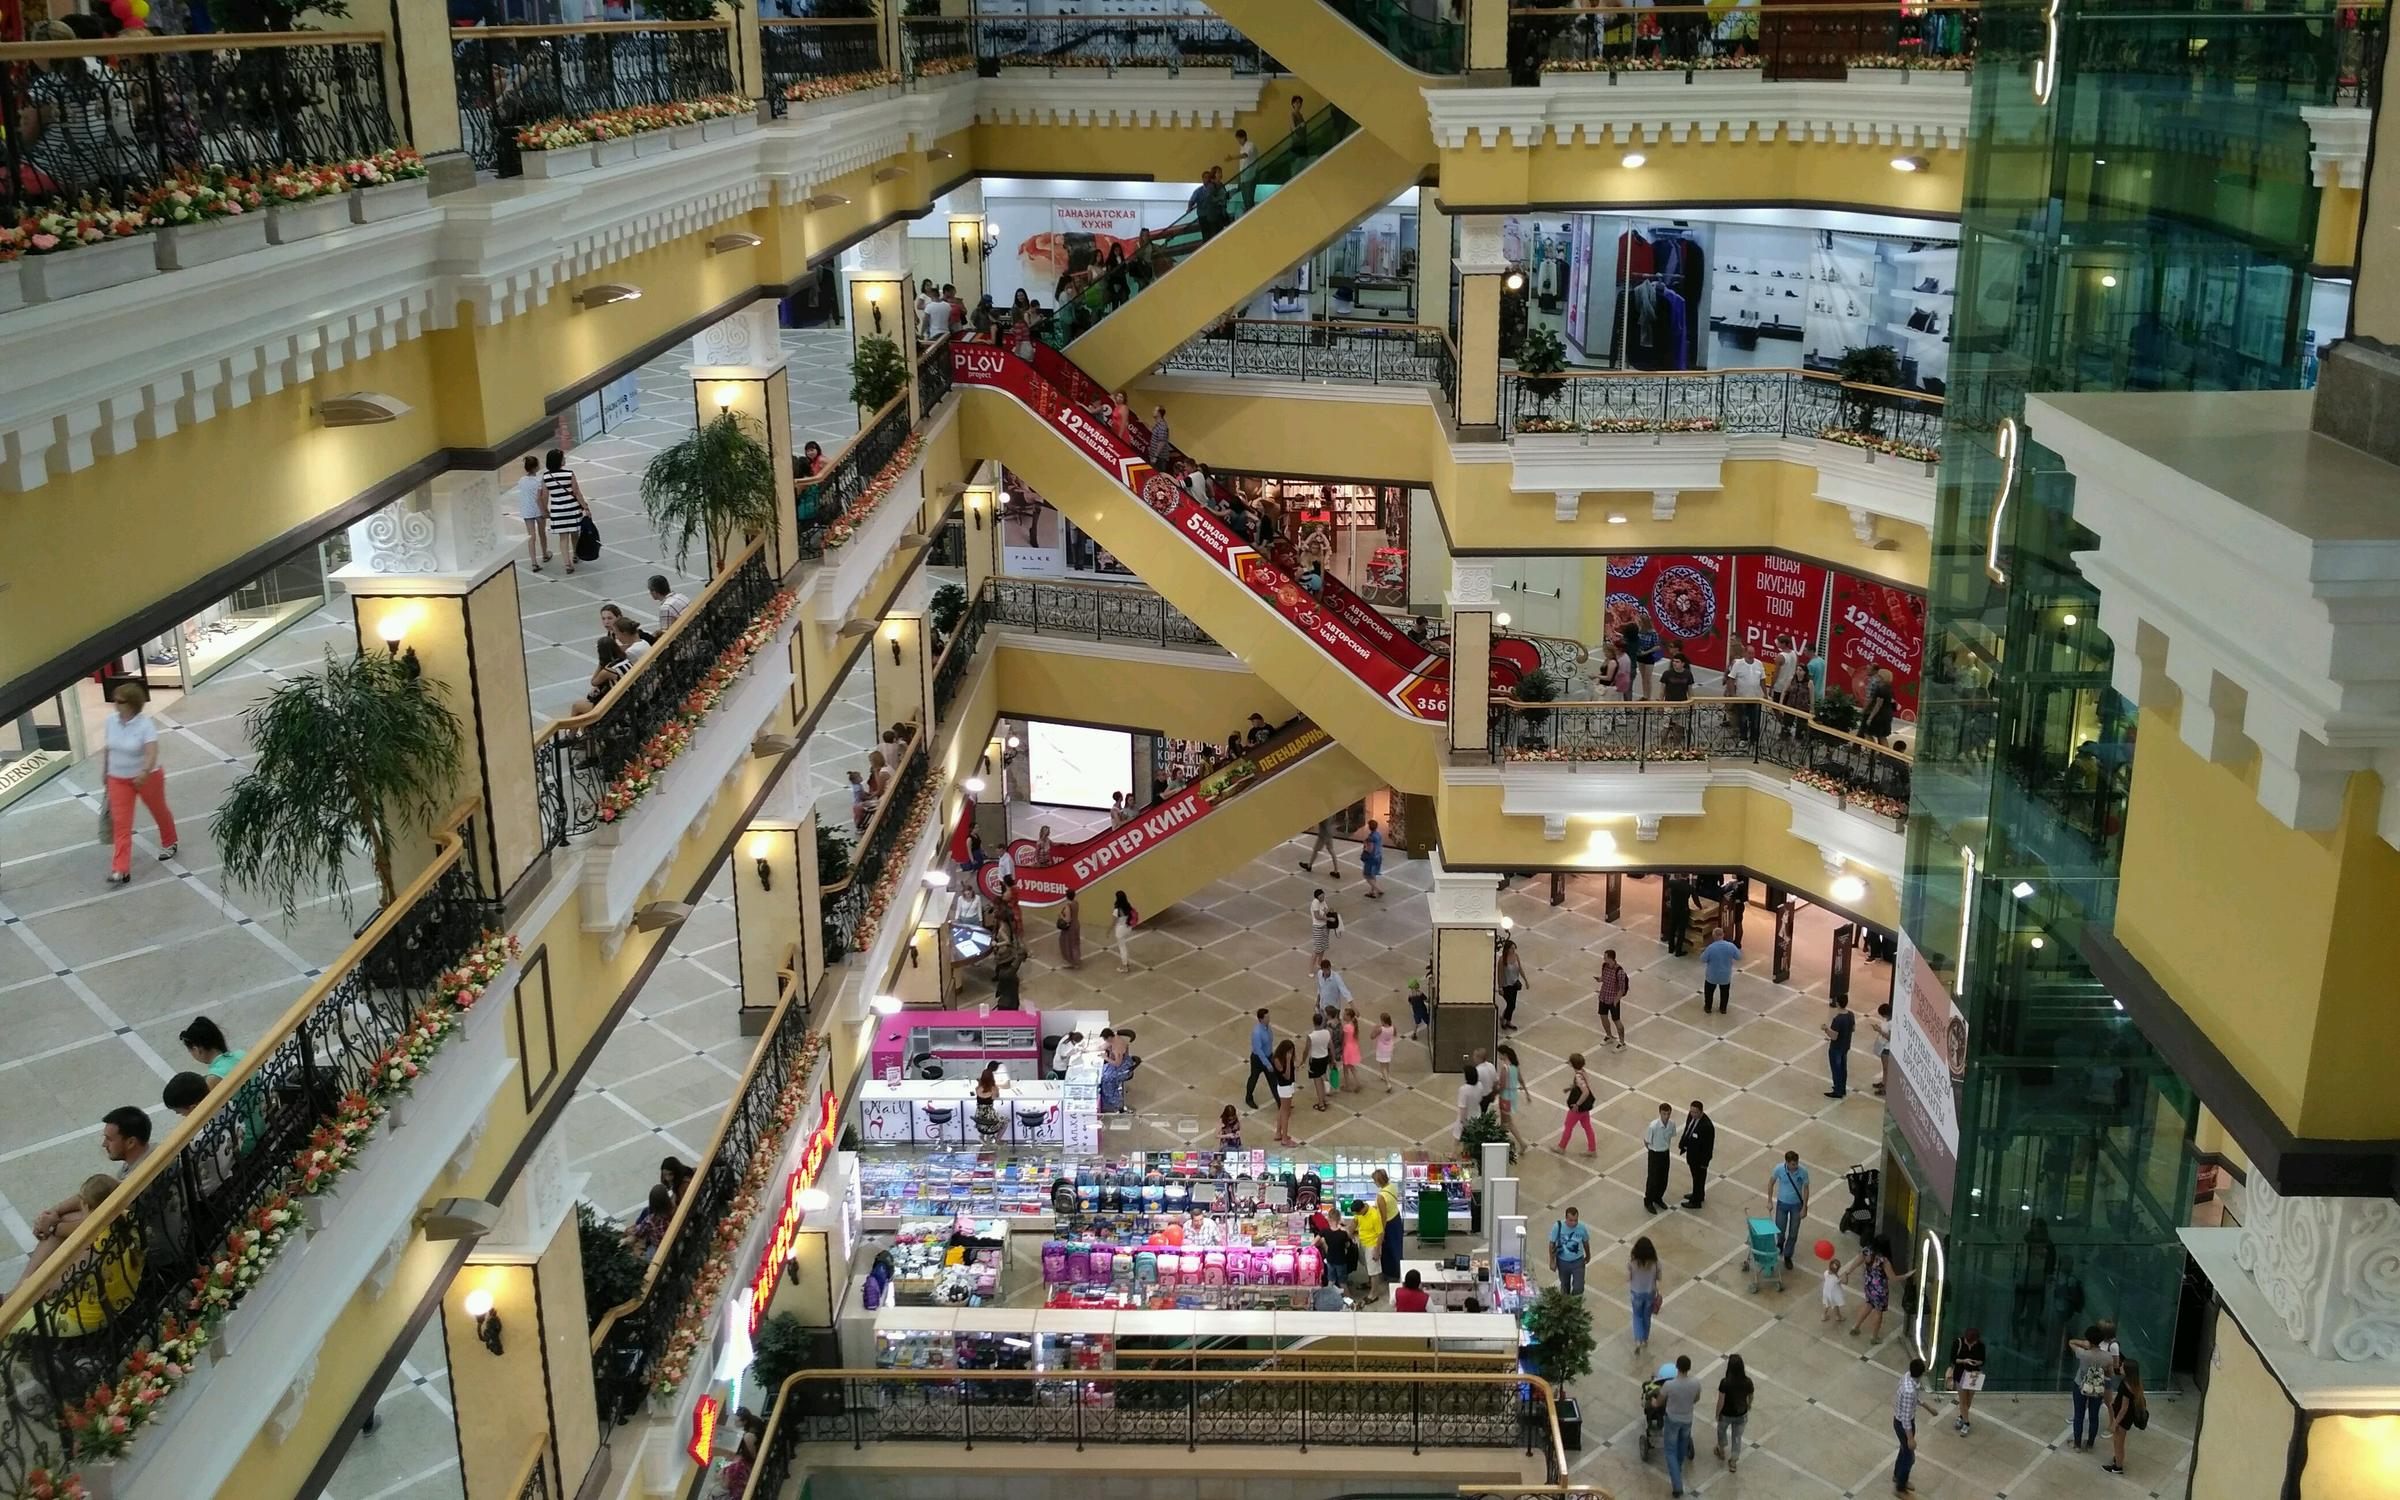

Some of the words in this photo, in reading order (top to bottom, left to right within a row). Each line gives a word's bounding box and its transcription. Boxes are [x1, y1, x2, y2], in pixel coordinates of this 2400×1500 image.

[1058, 208, 1136, 219] ПАНАЗИАТСКАЯ
[1081, 220, 1113, 229] КУХНЯ
[954, 354, 1005, 373] PLOV
[968, 371, 992, 380] project
[1057, 407, 1084, 434] 12
[1082, 422, 1109, 447] ВИДОВ
[1077, 429, 1119, 466] ШАШЛЫКА
[1186, 512, 1205, 530] 5
[1202, 520, 1230, 545] ВИДОВ
[1196, 528, 1224, 553] ПЛОВА
[1764, 555, 1801, 575] НОВАЯ
[1756, 571, 1806, 599] ВКУСНАЯ
[1343, 611, 1361, 627] ЧАЙ
[1766, 595, 1794, 618] ТВОЯ
[1844, 604, 1869, 631] 12
[1348, 604, 1394, 642] АВТОРСКИЙ
[1869, 617, 1897, 641] ВИДОВ
[1320, 628, 1337, 645] ЧАЙ
[1324, 621, 1371, 660] АВТОРСКИЙ
[1865, 626, 1908, 660] ШАШЛЫКА
[1856, 645, 1876, 662] ЧАЙ
[1860, 636, 1912, 675] АВТОРСКИЙ
[1157, 750, 1216, 765] КОРРЕКЦЯ
[0, 752, 49, 791] DERSON
[1073, 829, 1144, 880] БУРГЕР
[1143, 795, 1198, 839] КИНГ
[1903, 1013, 1932, 1065] ЭЛИТНЫЕ
[1932, 1059, 1951, 1099] ЧАСЫ
[1902, 1048, 1945, 1127] БРИЛЛИАНТЫ
[1912, 1045, 1943, 1105] КРУПНЫЕ
[864, 1100, 908, 1115] Nail
